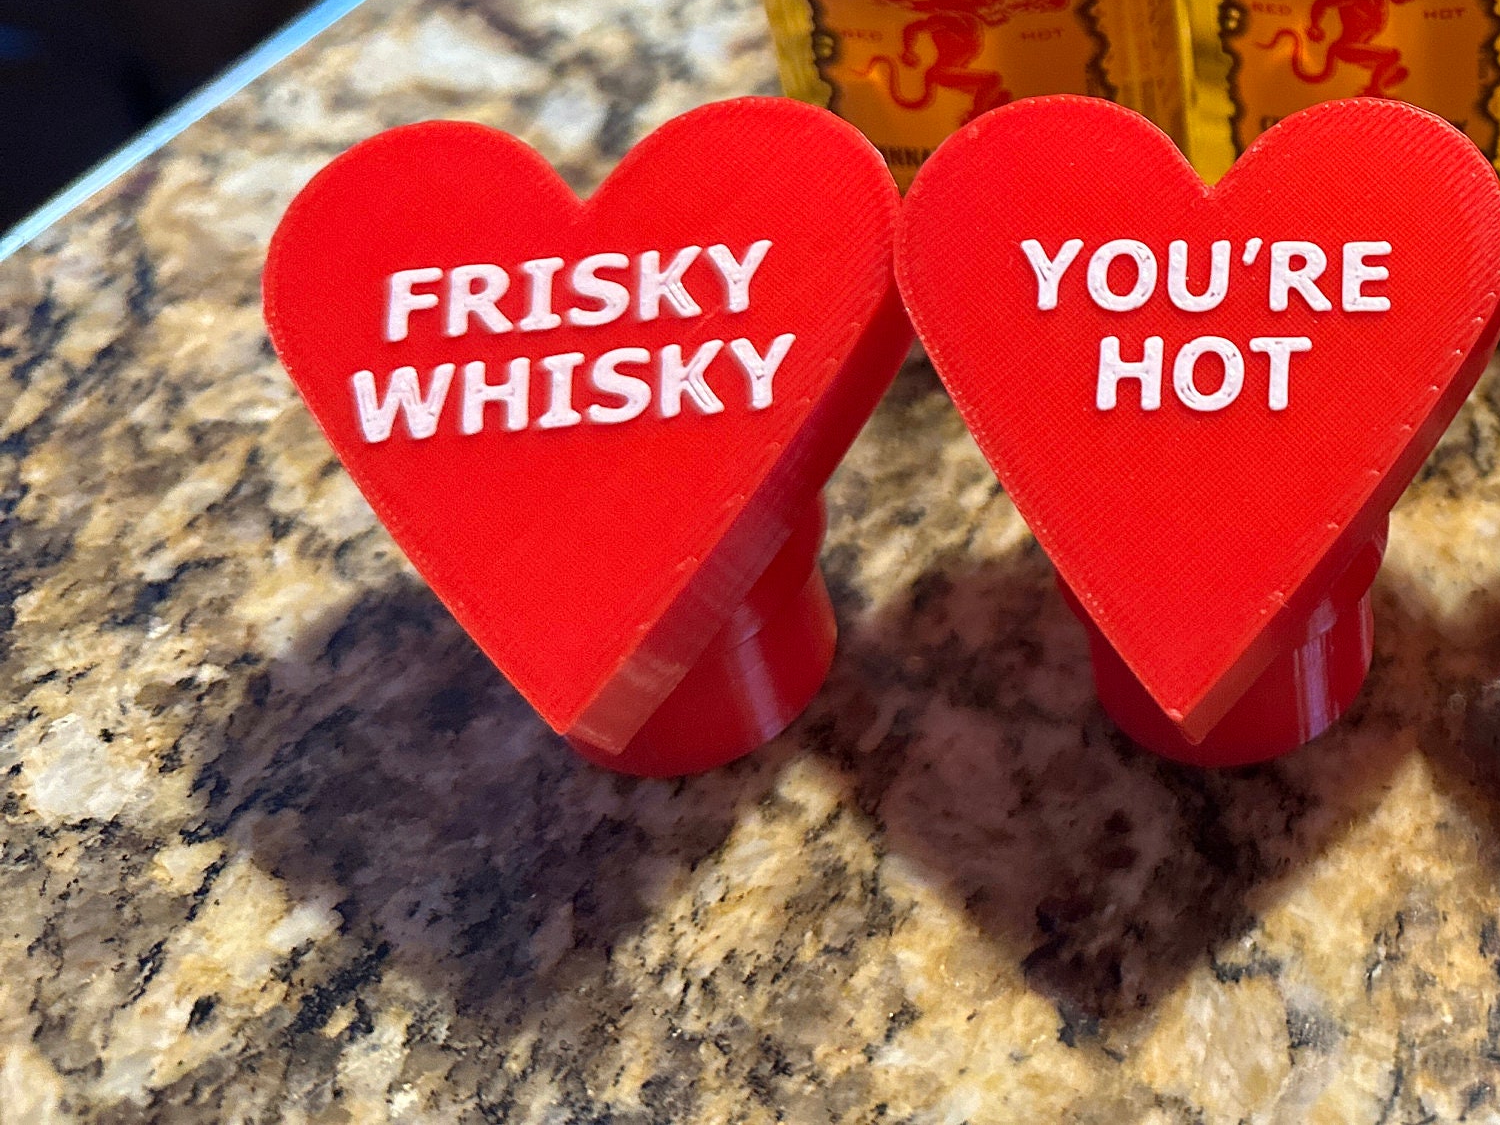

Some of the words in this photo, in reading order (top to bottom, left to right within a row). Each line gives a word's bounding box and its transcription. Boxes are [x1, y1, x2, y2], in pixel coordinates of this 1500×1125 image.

[1251, 1, 1293, 17] RED
[1423, 7, 1466, 21] HOT
[384, 239, 774, 343] FRISKY
[351, 333, 797, 444] WHISKY
[1096, 336, 1313, 412] HOT
